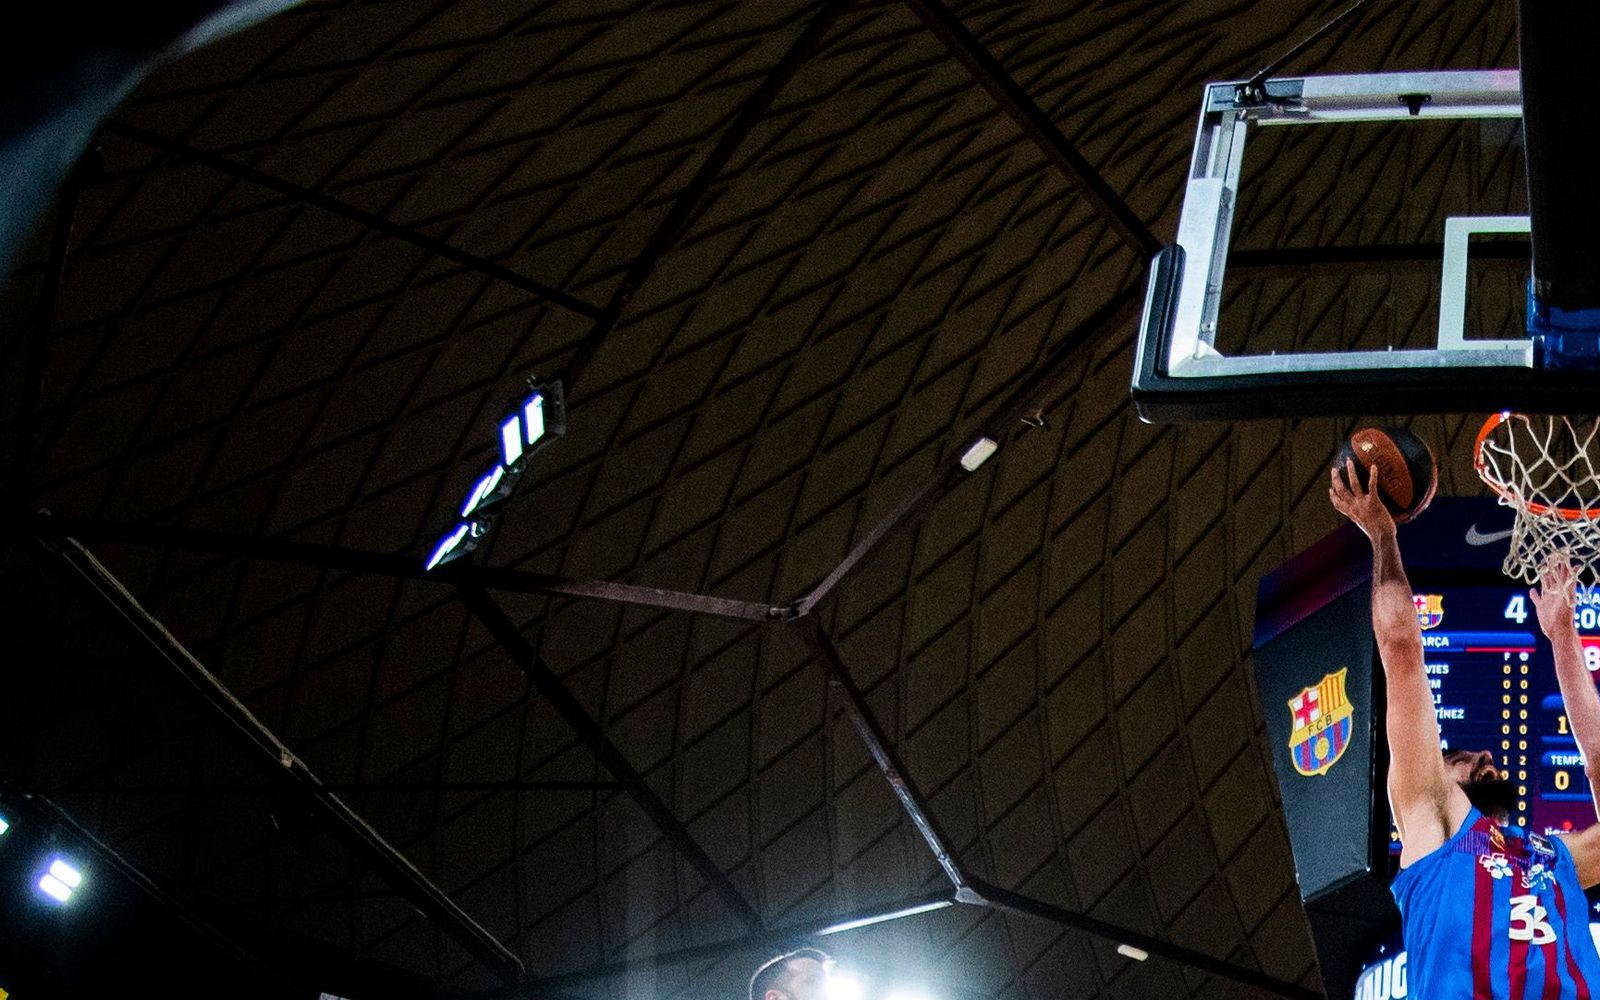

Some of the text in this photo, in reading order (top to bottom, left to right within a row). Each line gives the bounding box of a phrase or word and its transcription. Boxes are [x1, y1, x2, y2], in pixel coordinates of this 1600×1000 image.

[1504, 596, 1527, 623] 4
[1421, 637, 1449, 648] ARÇA
[1555, 771, 1569, 790] 0
